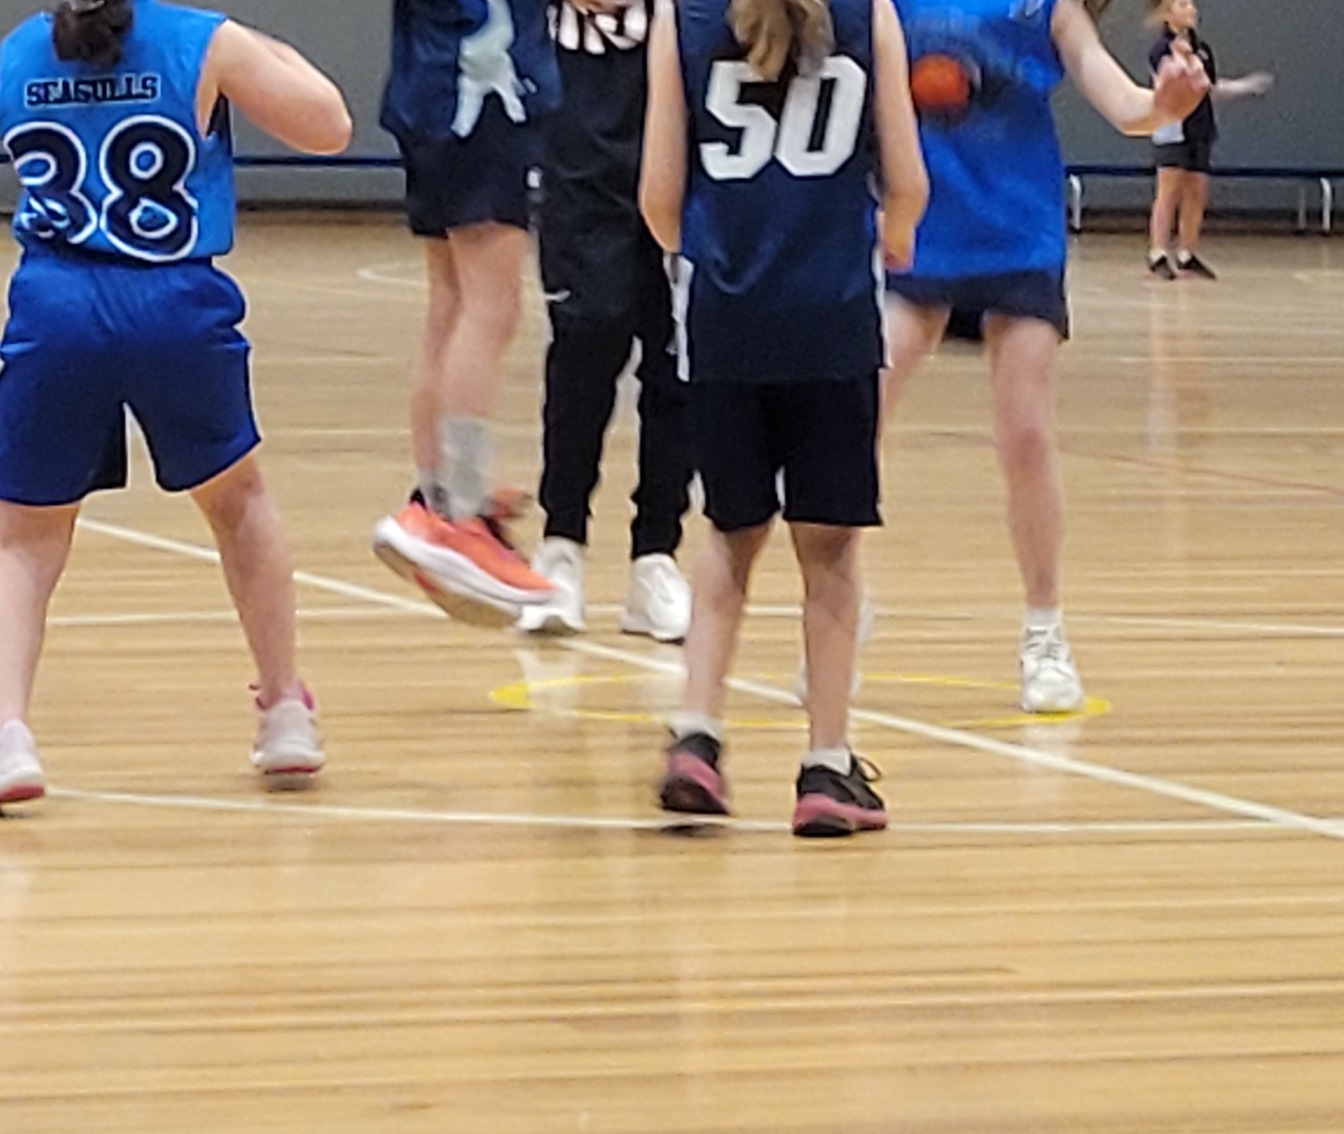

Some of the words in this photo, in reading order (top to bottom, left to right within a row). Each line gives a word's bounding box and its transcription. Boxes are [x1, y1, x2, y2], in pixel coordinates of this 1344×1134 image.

[24, 73, 162, 109] SEAGULLS
[698, 54, 867, 181] 50
[2, 114, 199, 262] 38
